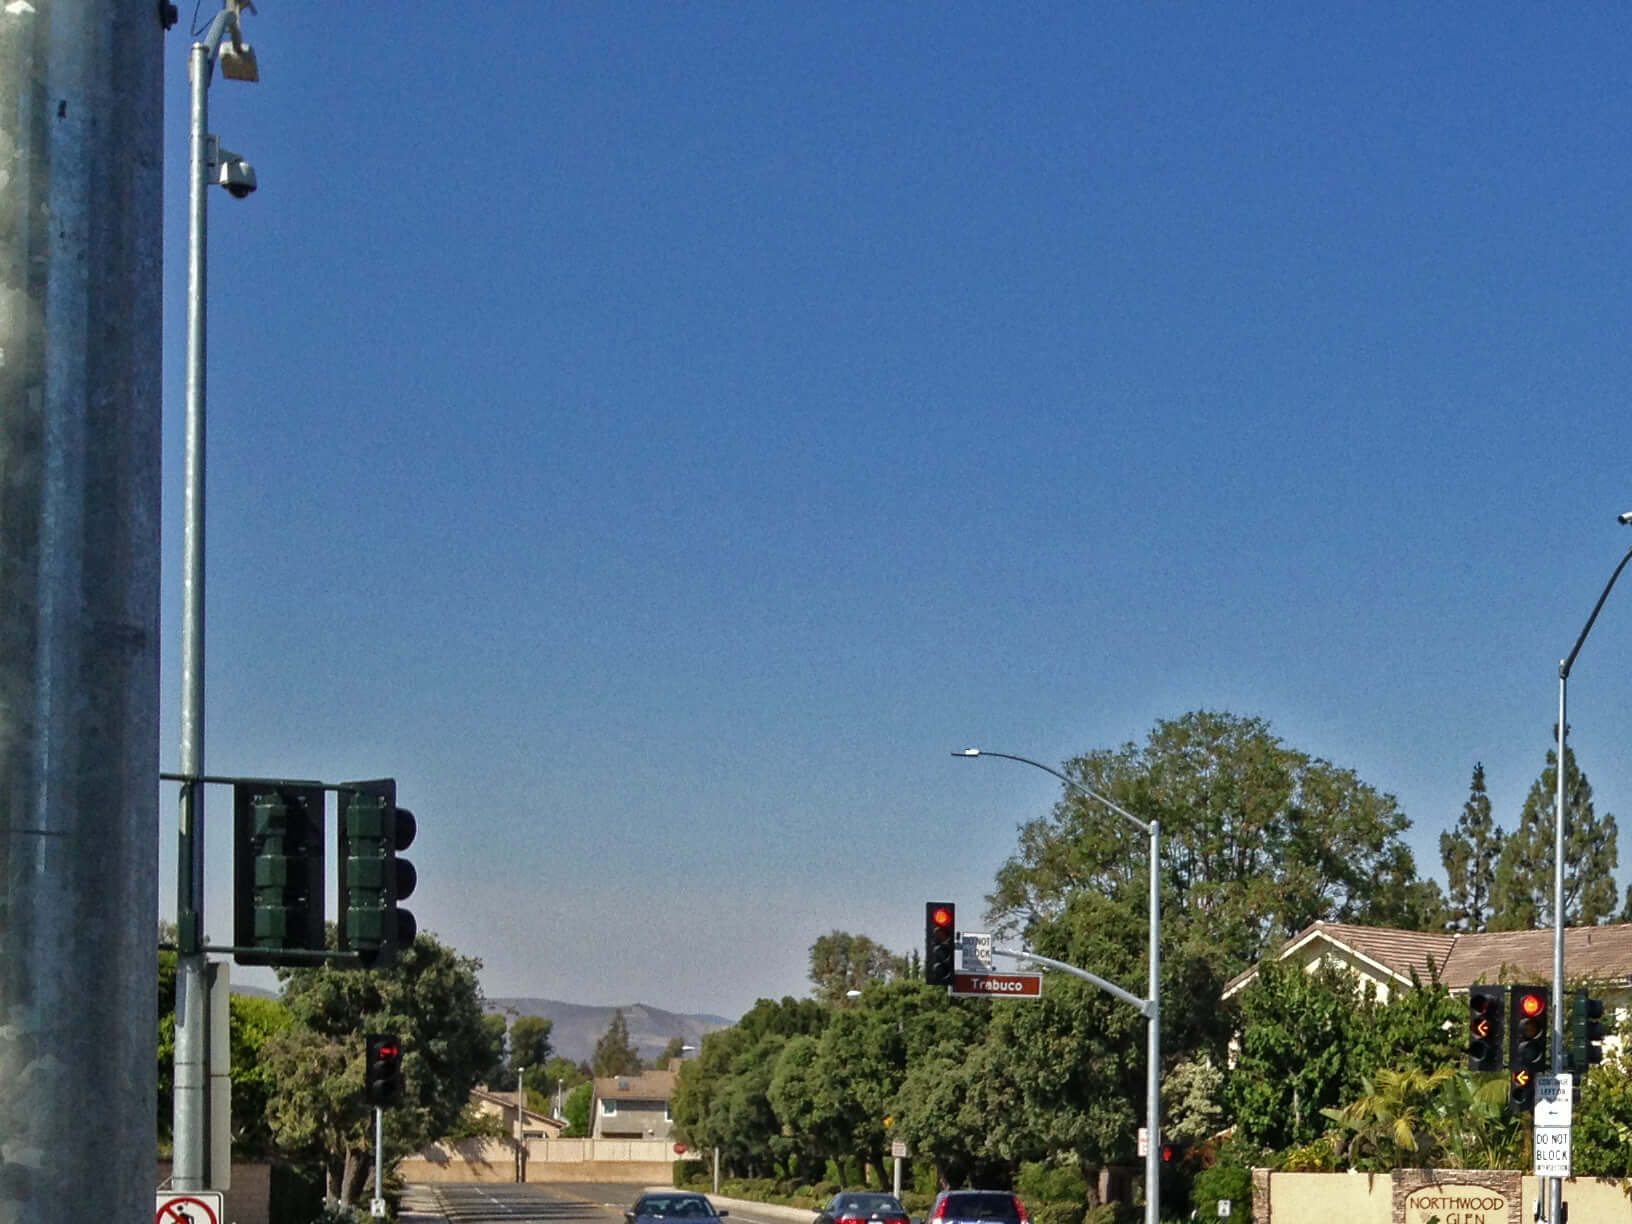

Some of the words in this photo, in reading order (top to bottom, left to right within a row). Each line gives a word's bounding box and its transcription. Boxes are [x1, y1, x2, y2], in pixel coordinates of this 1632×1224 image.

[971, 978, 1023, 991] Trabuco
[1536, 1133, 1549, 1145] DO
[1552, 1133, 1568, 1145] NOT
[1536, 1150, 1568, 1161] BLOCK
[1410, 1197, 1504, 1211] NORTHWOOD
